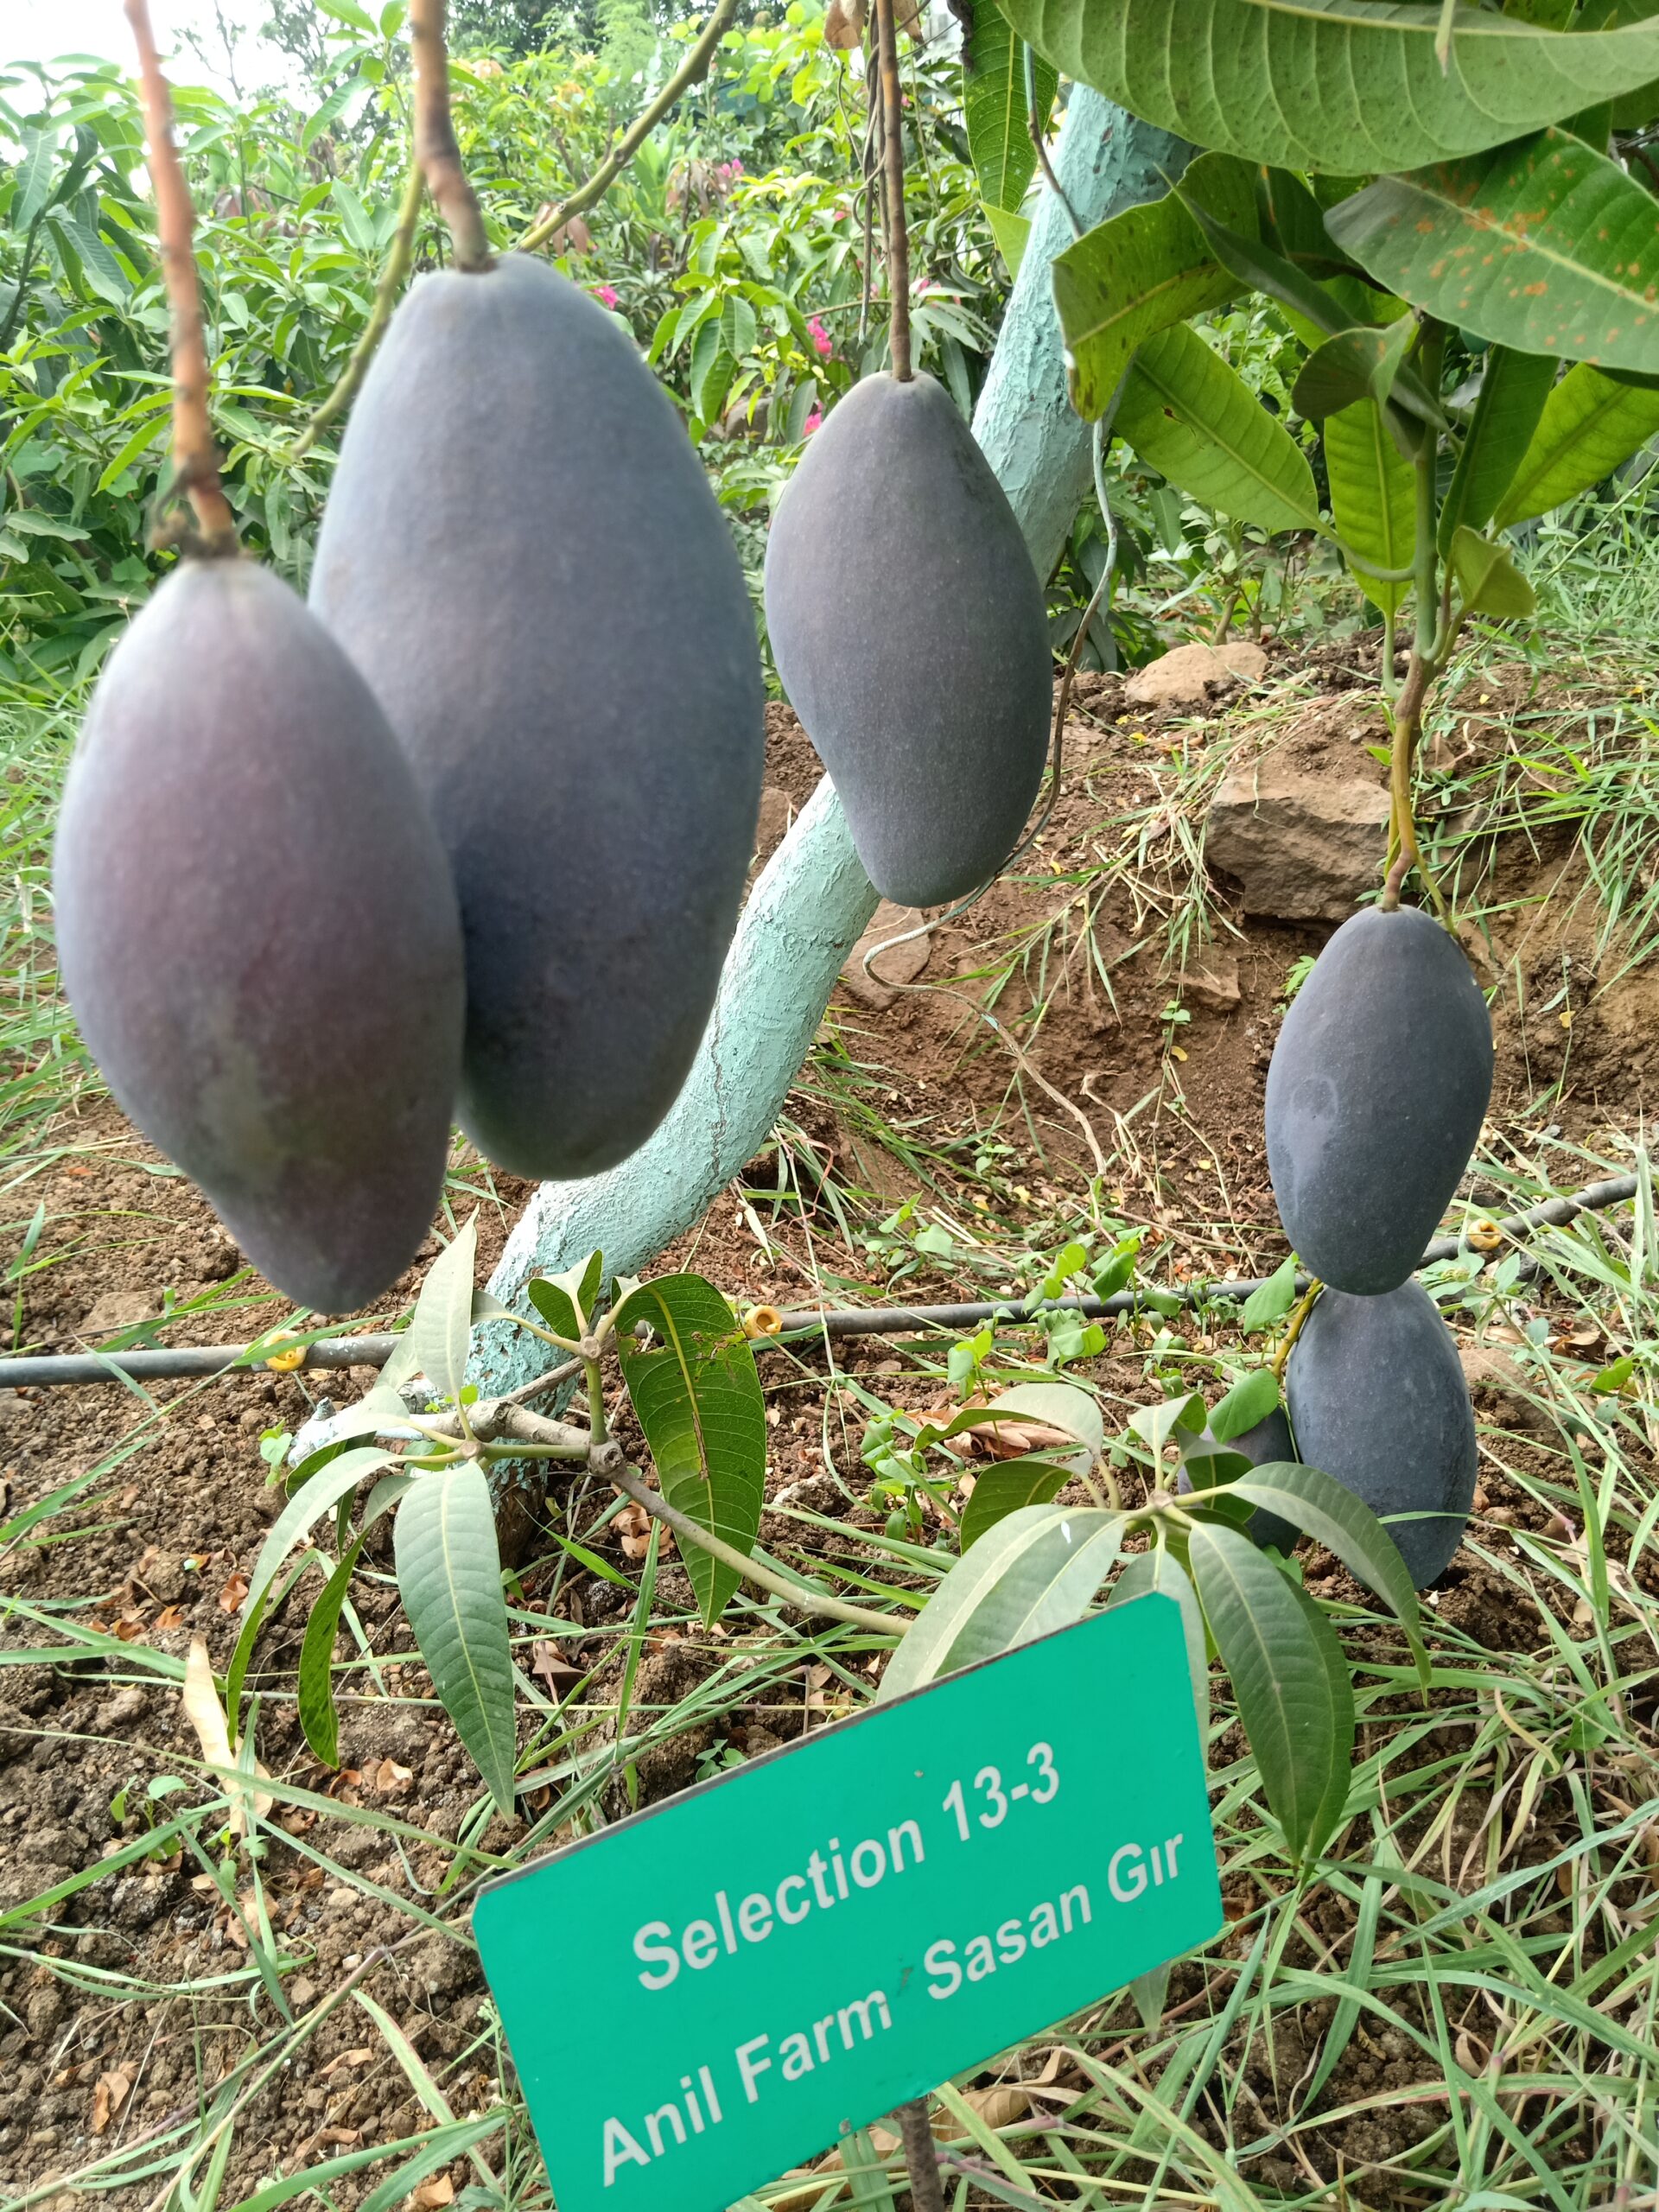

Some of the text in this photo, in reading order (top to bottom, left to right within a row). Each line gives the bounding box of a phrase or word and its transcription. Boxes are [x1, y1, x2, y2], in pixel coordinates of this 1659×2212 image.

[632, 1741, 1060, 1990] Selection 13-3
[603, 2066, 722, 2187] Anil
[734, 1990, 892, 2104] Farm
[924, 1885, 1091, 1999] Sasan
